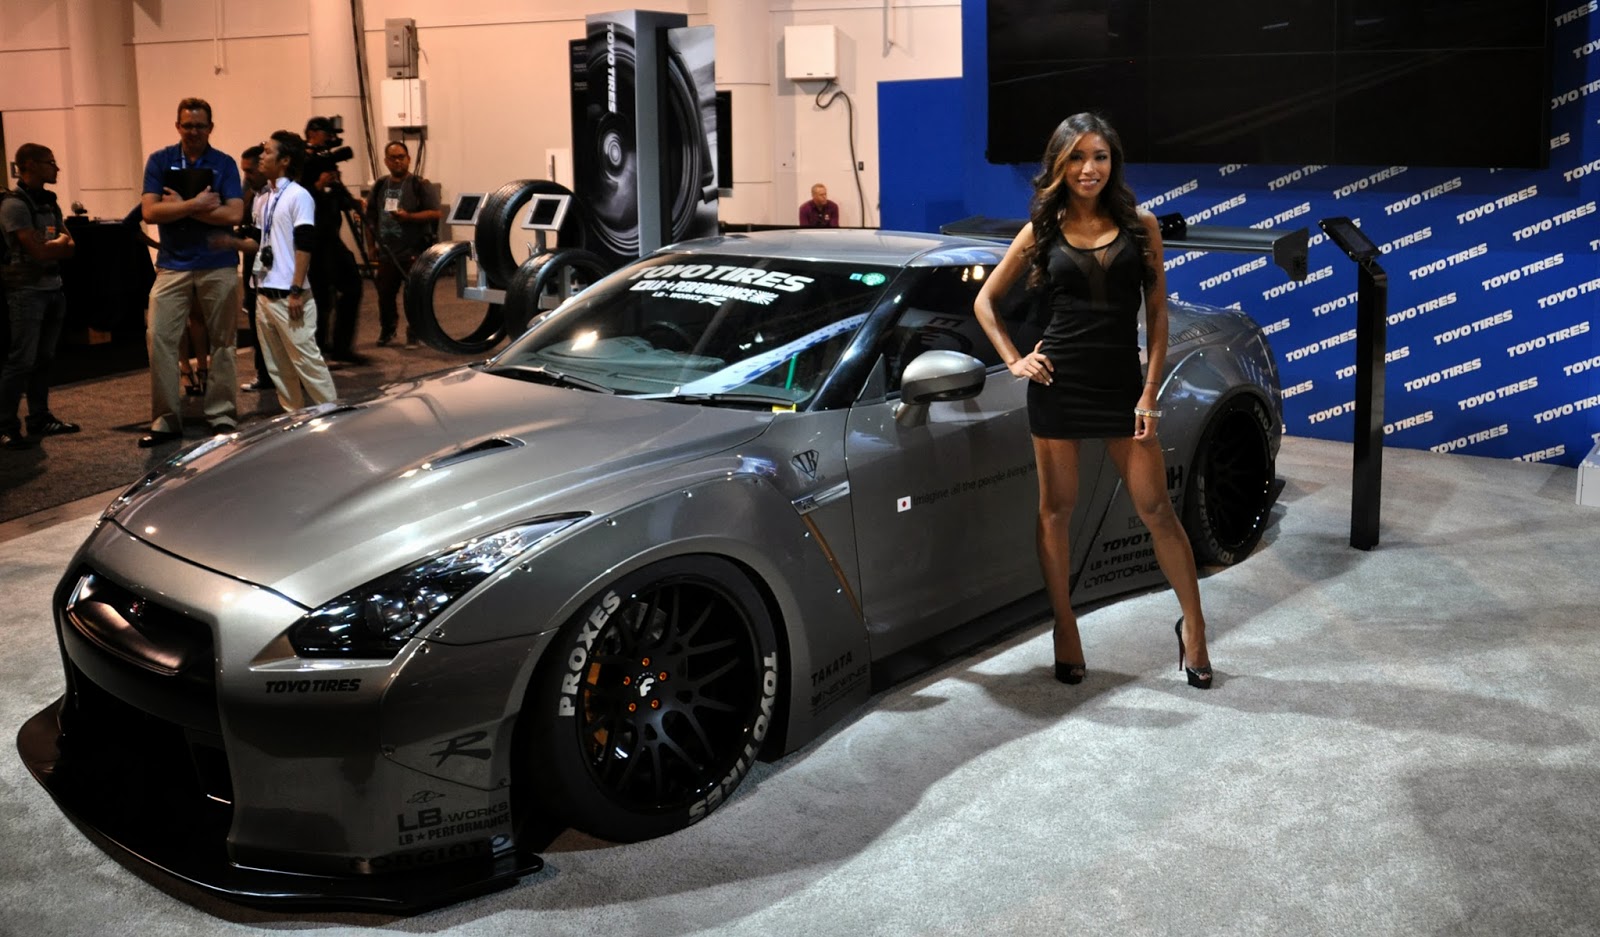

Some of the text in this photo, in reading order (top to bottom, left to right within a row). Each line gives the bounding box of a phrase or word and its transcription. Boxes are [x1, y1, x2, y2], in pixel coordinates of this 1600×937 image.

[1555, 0, 1598, 26] TIRES
[1573, 39, 1600, 58] TOY
[607, 22, 617, 114] TOYO TIRES
[1580, 79, 1600, 95] TIR
[1268, 170, 1301, 190] TOYO
[1333, 166, 1407, 199] TOYO TIRES
[1136, 180, 1198, 212] OYO TIRES
[1184, 194, 1246, 225] OYO TIRES
[1385, 177, 1461, 215] TOYO TIRES
[1457, 185, 1537, 224] TOYO TIRES
[1274, 202, 1310, 224] TIRES
[1513, 201, 1596, 241] TOYO TIRES
[1393, 227, 1432, 249] TIRES
[1163, 255, 1185, 271] OYO
[1200, 256, 1267, 290] TOYO TIRES
[1410, 243, 1487, 280] TOYO TIRES
[1482, 253, 1564, 290] TOYO TIRES
[629, 264, 815, 292] TOYO TIRES
[1263, 281, 1296, 300] TOYO
[1313, 297, 1347, 316] TOYO
[1417, 293, 1456, 314] TIRES
[1538, 278, 1600, 308] TOYO TIR
[1434, 310, 1513, 345] TOYO TIRES
[1507, 321, 1589, 357] TOYO TIRES
[1286, 329, 1357, 362] TOYO TIRES
[1385, 346, 1409, 363] RES
[1404, 358, 1481, 391] TOYO TIRES
[1458, 377, 1538, 410] TOYO TIRES
[1308, 406, 1342, 424] TOYO
[1395, 411, 1433, 430] TIRES
[1534, 395, 1600, 423] TOYO TIR
[1468, 424, 1508, 444] TIRES
[1522, 445, 1565, 463] TIRES
[1103, 534, 1143, 553] TOYO
[558, 590, 621, 717] PROXES
[811, 651, 852, 687] TAKATA
[265, 678, 361, 694] TOYO TIRES
[752, 651, 777, 742] TOYO
[688, 743, 756, 824] TIRES
[428, 813, 511, 840] PERFORMANCE
